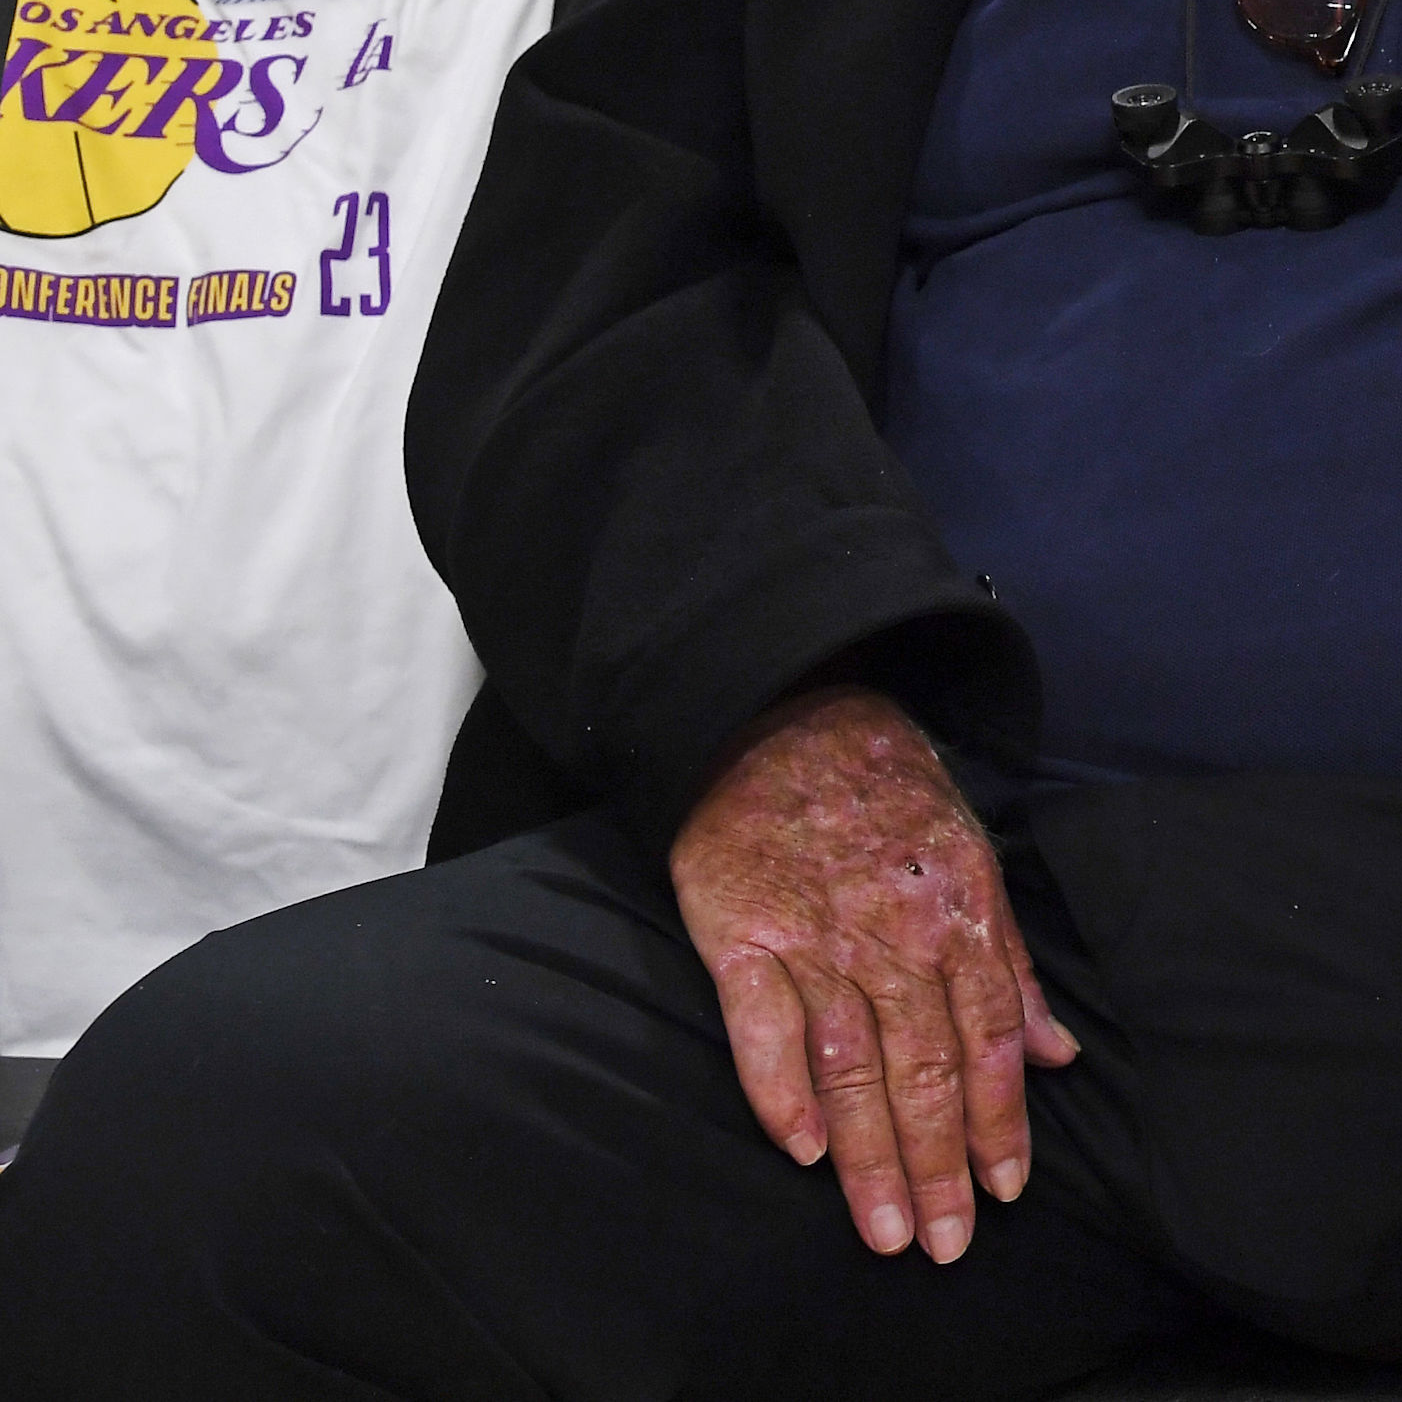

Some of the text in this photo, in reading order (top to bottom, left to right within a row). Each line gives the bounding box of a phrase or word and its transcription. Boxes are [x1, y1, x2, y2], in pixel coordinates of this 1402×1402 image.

[86, 11, 316, 42] ANGELES
[0, 38, 324, 174] KERS
[188, 271, 297, 322] FINALS
[320, 191, 391, 316] 23
